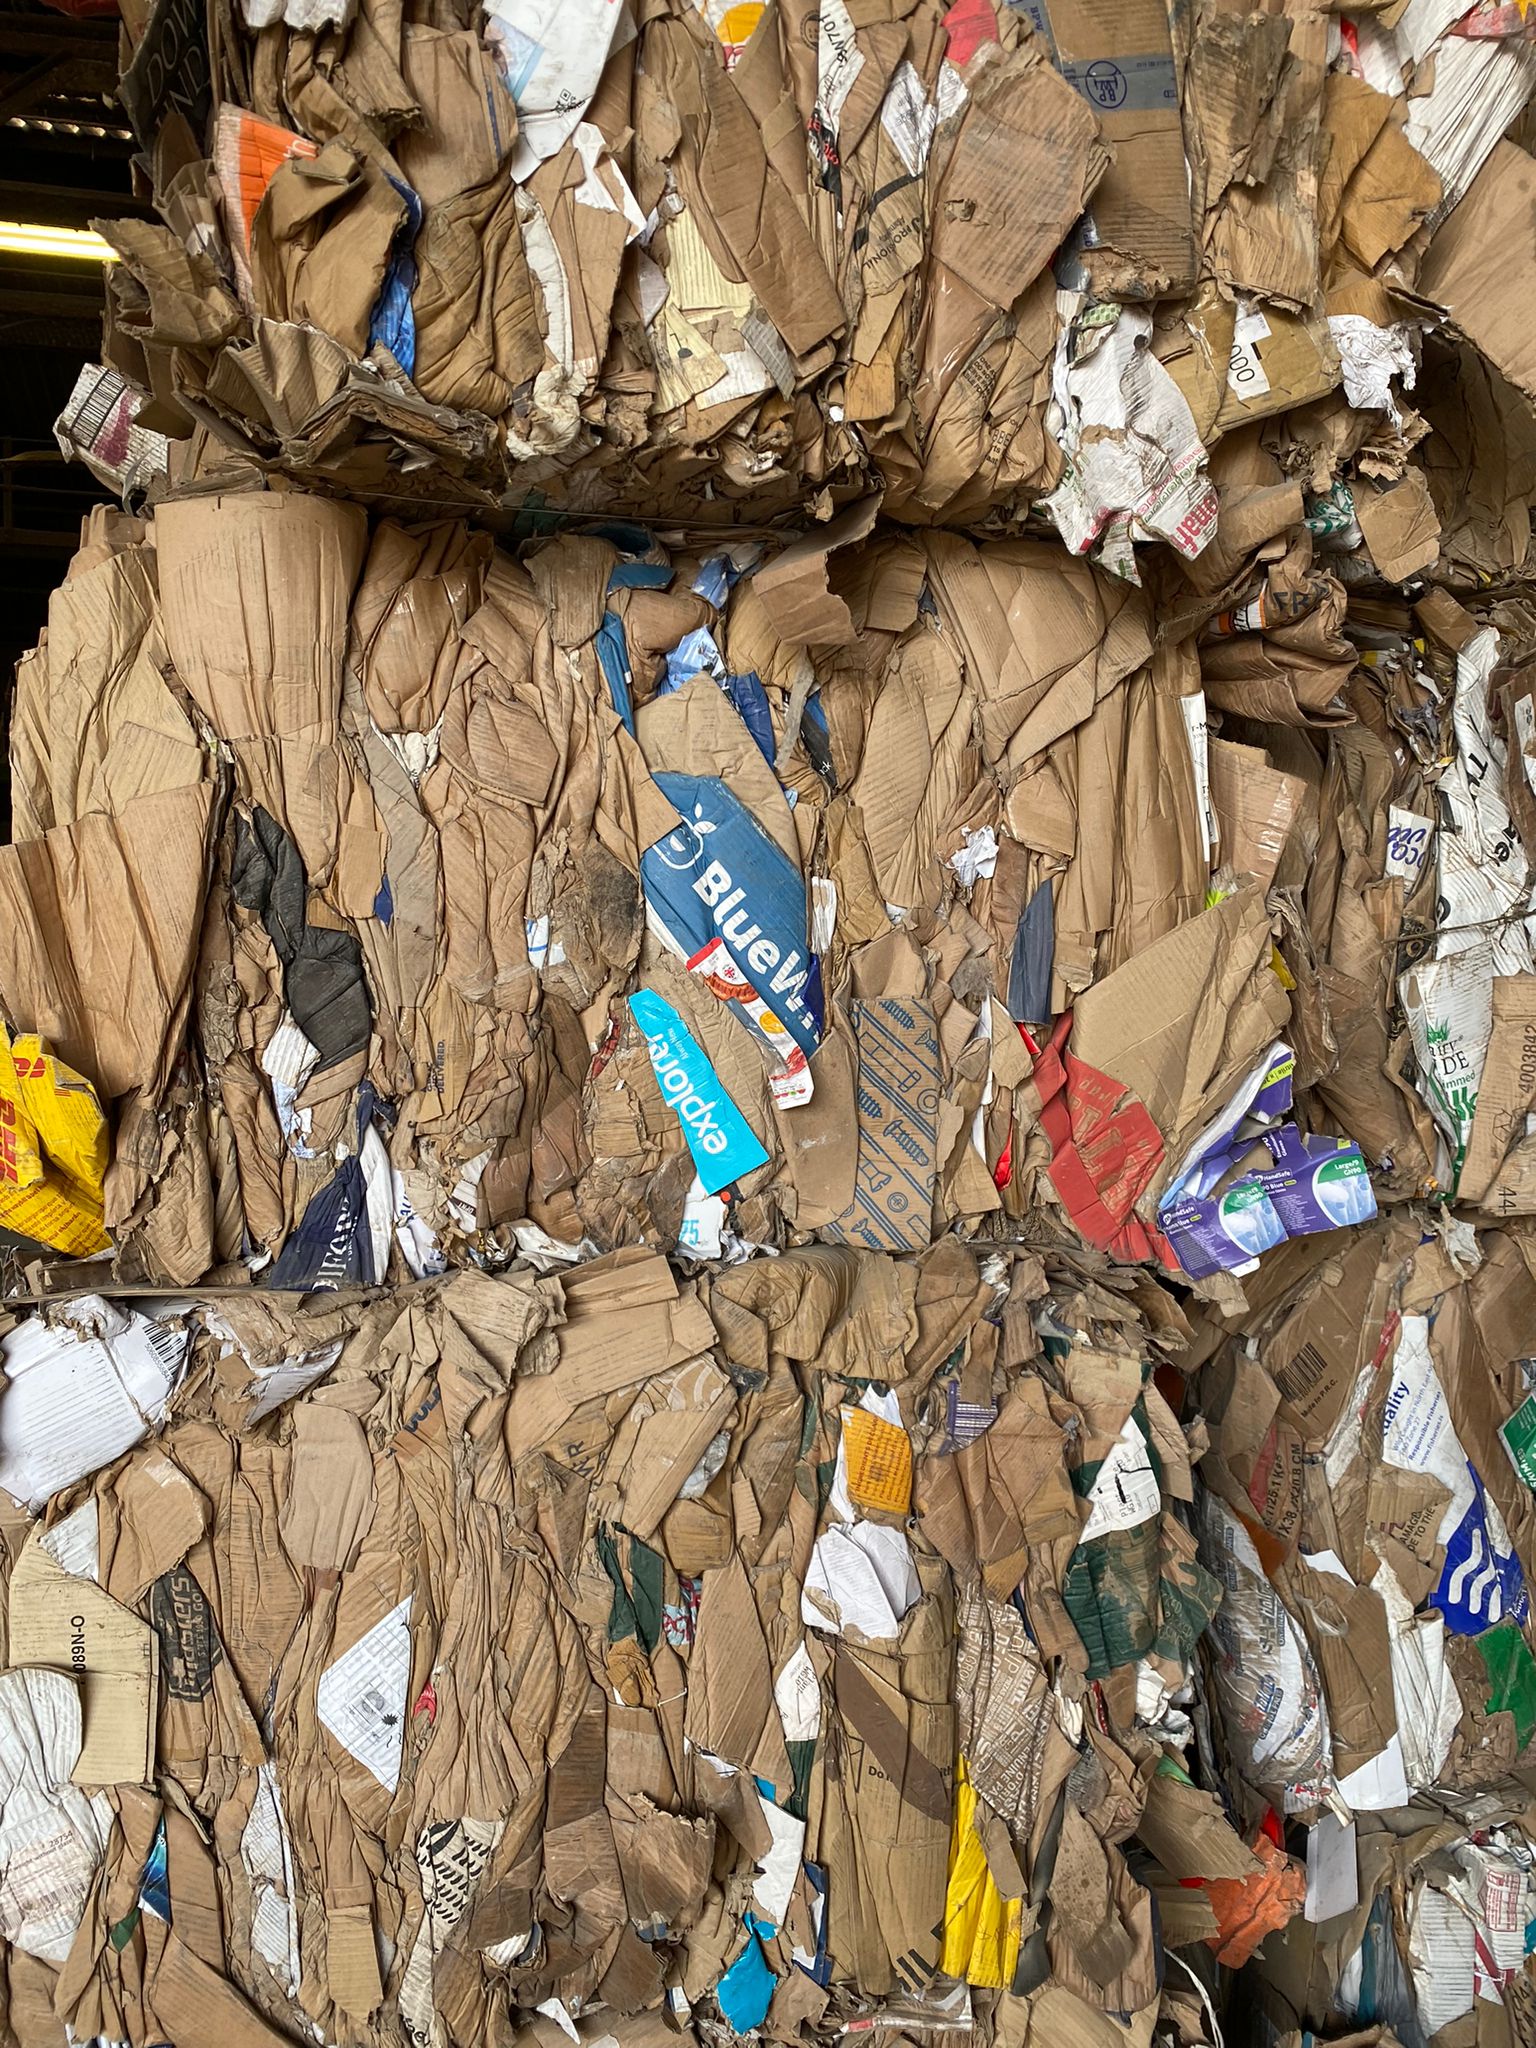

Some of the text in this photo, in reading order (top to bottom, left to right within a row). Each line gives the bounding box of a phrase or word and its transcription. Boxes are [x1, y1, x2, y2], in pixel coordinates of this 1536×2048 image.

[692, 859, 817, 1025] BlueW
[649, 1033, 727, 1154] explorer
[1384, 1380, 1410, 1436] uality
[1408, 1391, 1442, 1461] Responsible Fisheries
[1291, 1443, 1301, 1464] CM
[1414, 1525, 1427, 1538] TO
[1421, 1507, 1436, 1525] THE
[868, 1766, 885, 1780] Do
